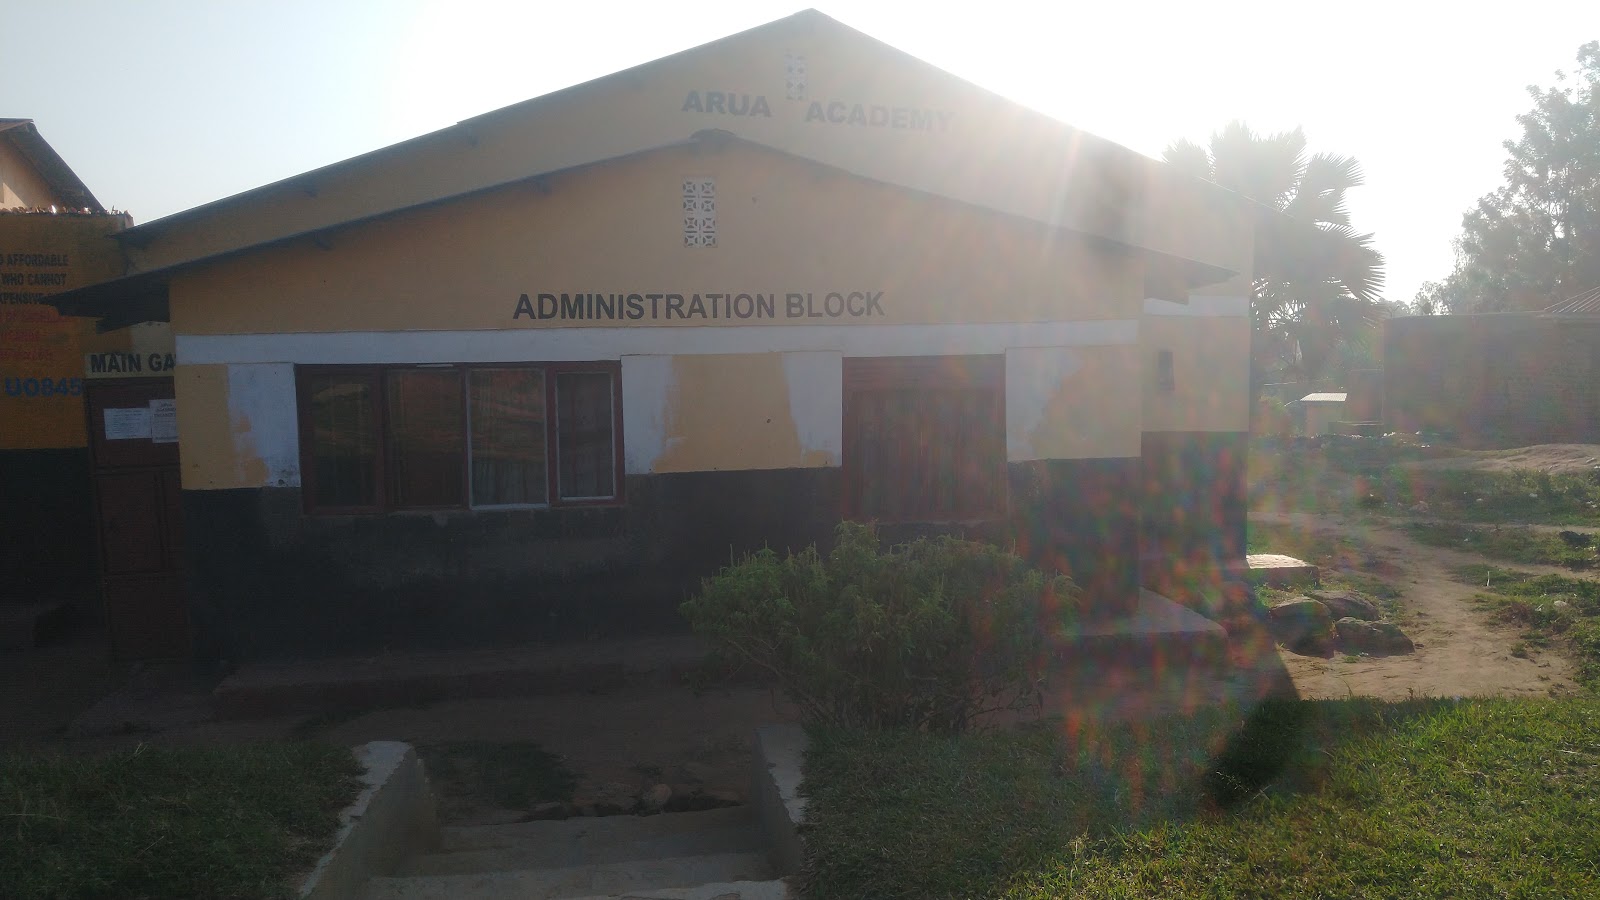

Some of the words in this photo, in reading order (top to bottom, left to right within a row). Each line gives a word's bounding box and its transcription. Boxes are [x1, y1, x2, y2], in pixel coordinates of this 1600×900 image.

[682, 90, 772, 118] ARUA
[805, 101, 956, 132] ACADEMY
[7, 253, 69, 267] AFFORDABLE
[1, 272, 24, 286] WHO
[28, 272, 67, 287] CANNOT
[513, 293, 775, 320] ADMINISTRATION
[785, 291, 885, 319] BLOCK
[91, 353, 142, 373] MAIN
[149, 353, 176, 372] GA
